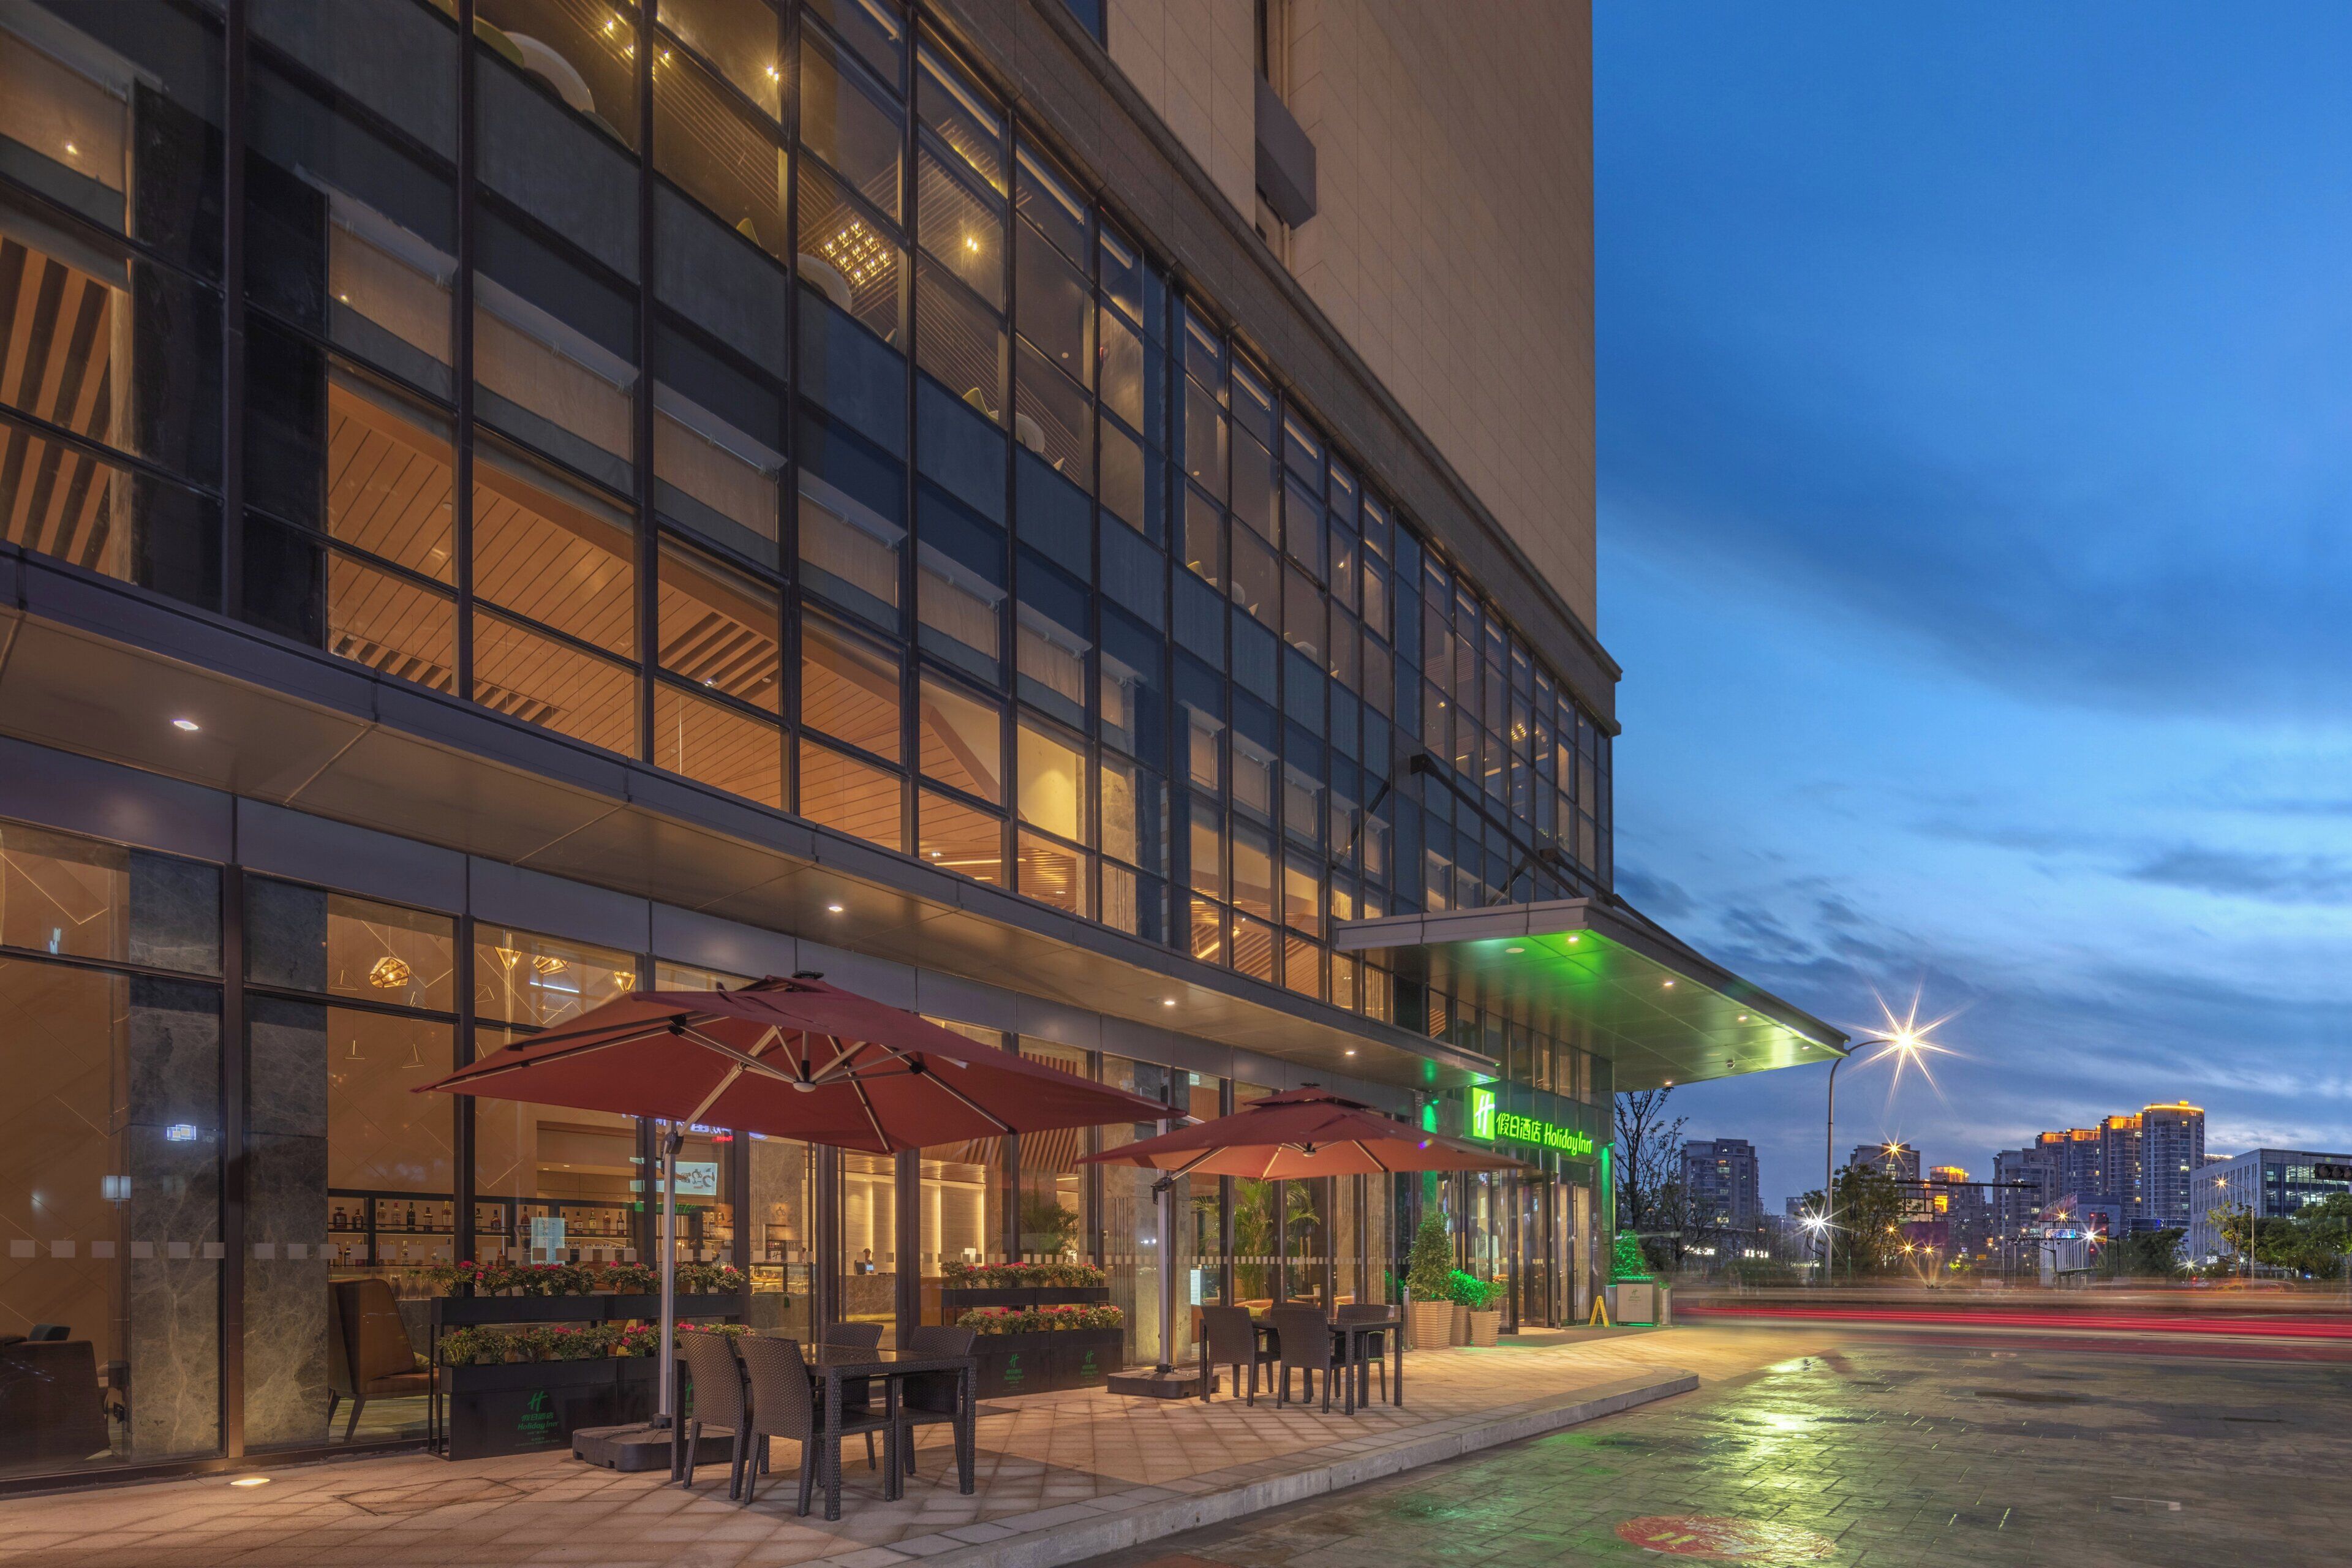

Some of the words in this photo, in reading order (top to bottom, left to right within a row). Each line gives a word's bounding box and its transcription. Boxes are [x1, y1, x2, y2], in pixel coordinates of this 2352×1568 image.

[1496, 1112, 1542, 1143] 假日酒店
[1544, 1122, 1578, 1156] Holiday
[1578, 1131, 1593, 1155] Inn
[517, 1422, 545, 1431] Holiday
